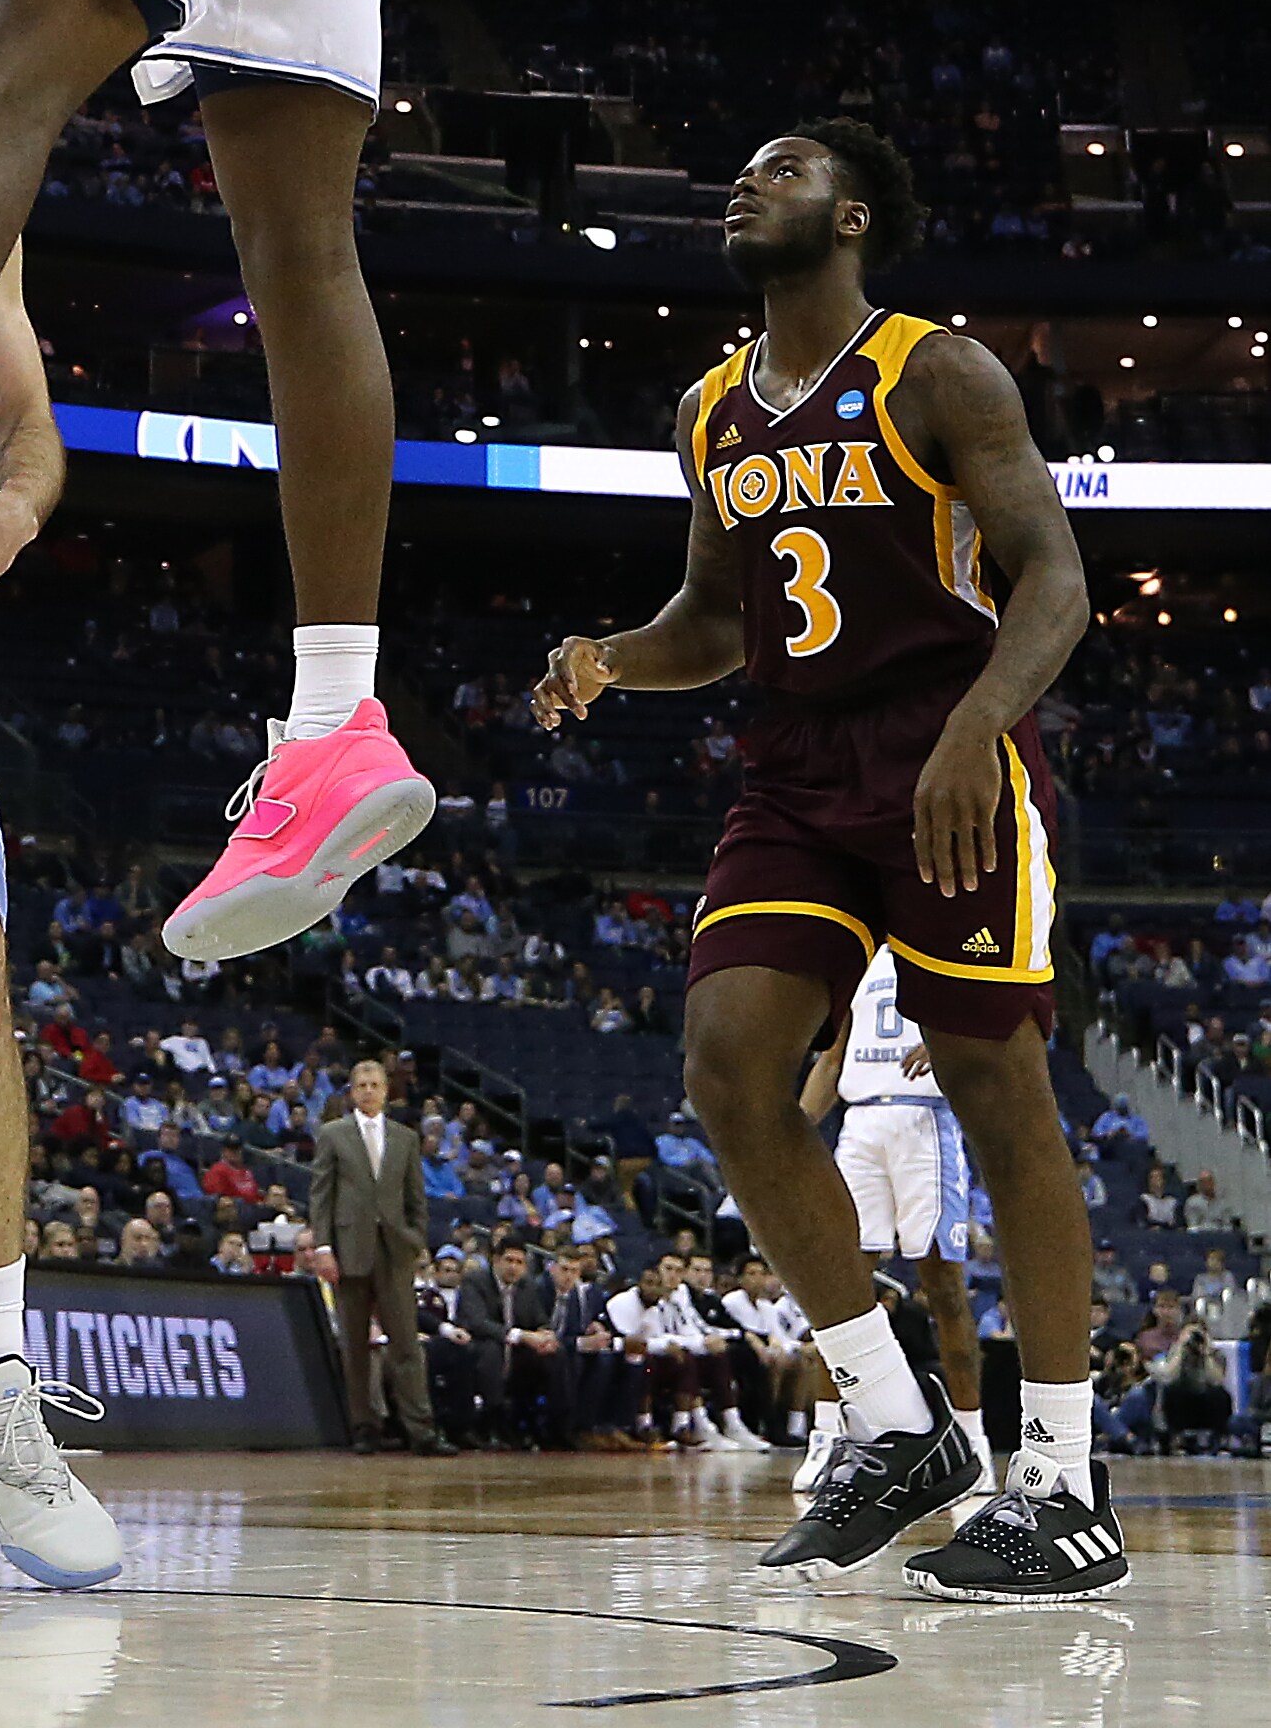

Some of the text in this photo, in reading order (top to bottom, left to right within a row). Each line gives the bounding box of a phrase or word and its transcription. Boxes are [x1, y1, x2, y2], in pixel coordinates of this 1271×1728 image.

[707, 441, 895, 531] IONA
[770, 526, 842, 657] 3
[526, 787, 568, 809] 107
